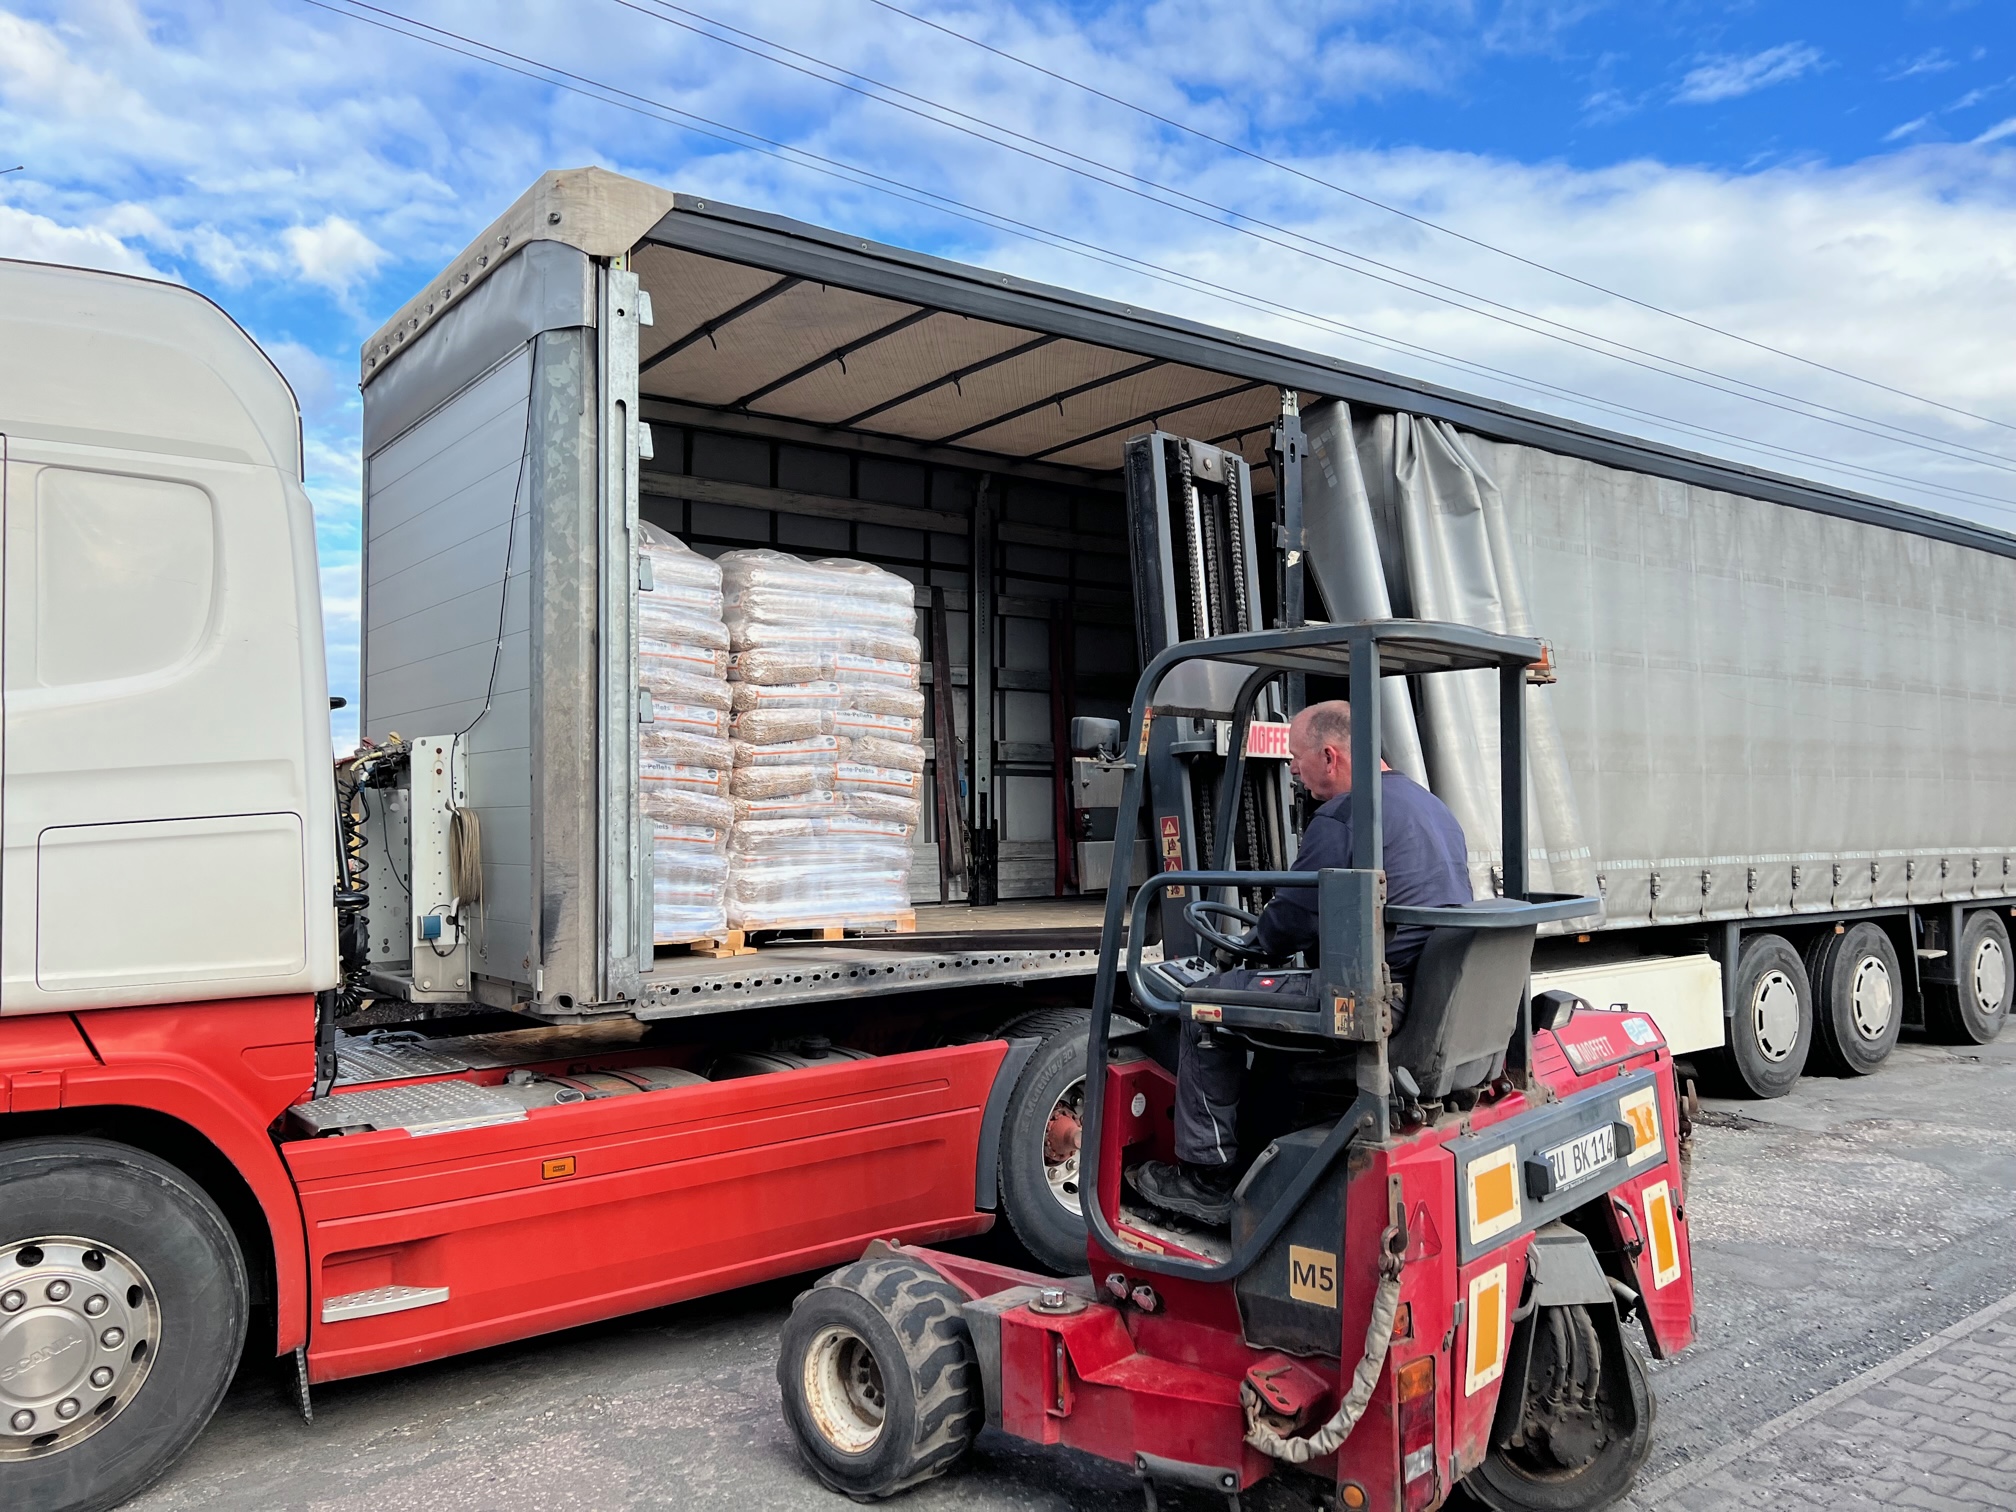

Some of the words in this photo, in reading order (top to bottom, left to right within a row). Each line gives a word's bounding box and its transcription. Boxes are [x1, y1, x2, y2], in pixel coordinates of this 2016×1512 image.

[1248, 725, 1290, 754] MOFFE
[1576, 1036, 1615, 1062] MOFFETT
[1573, 1140, 1590, 1174] BK
[1592, 1130, 1613, 1165] 114
[1293, 1260, 1333, 1291] M5
[0, 1334, 82, 1381] SCANIA
